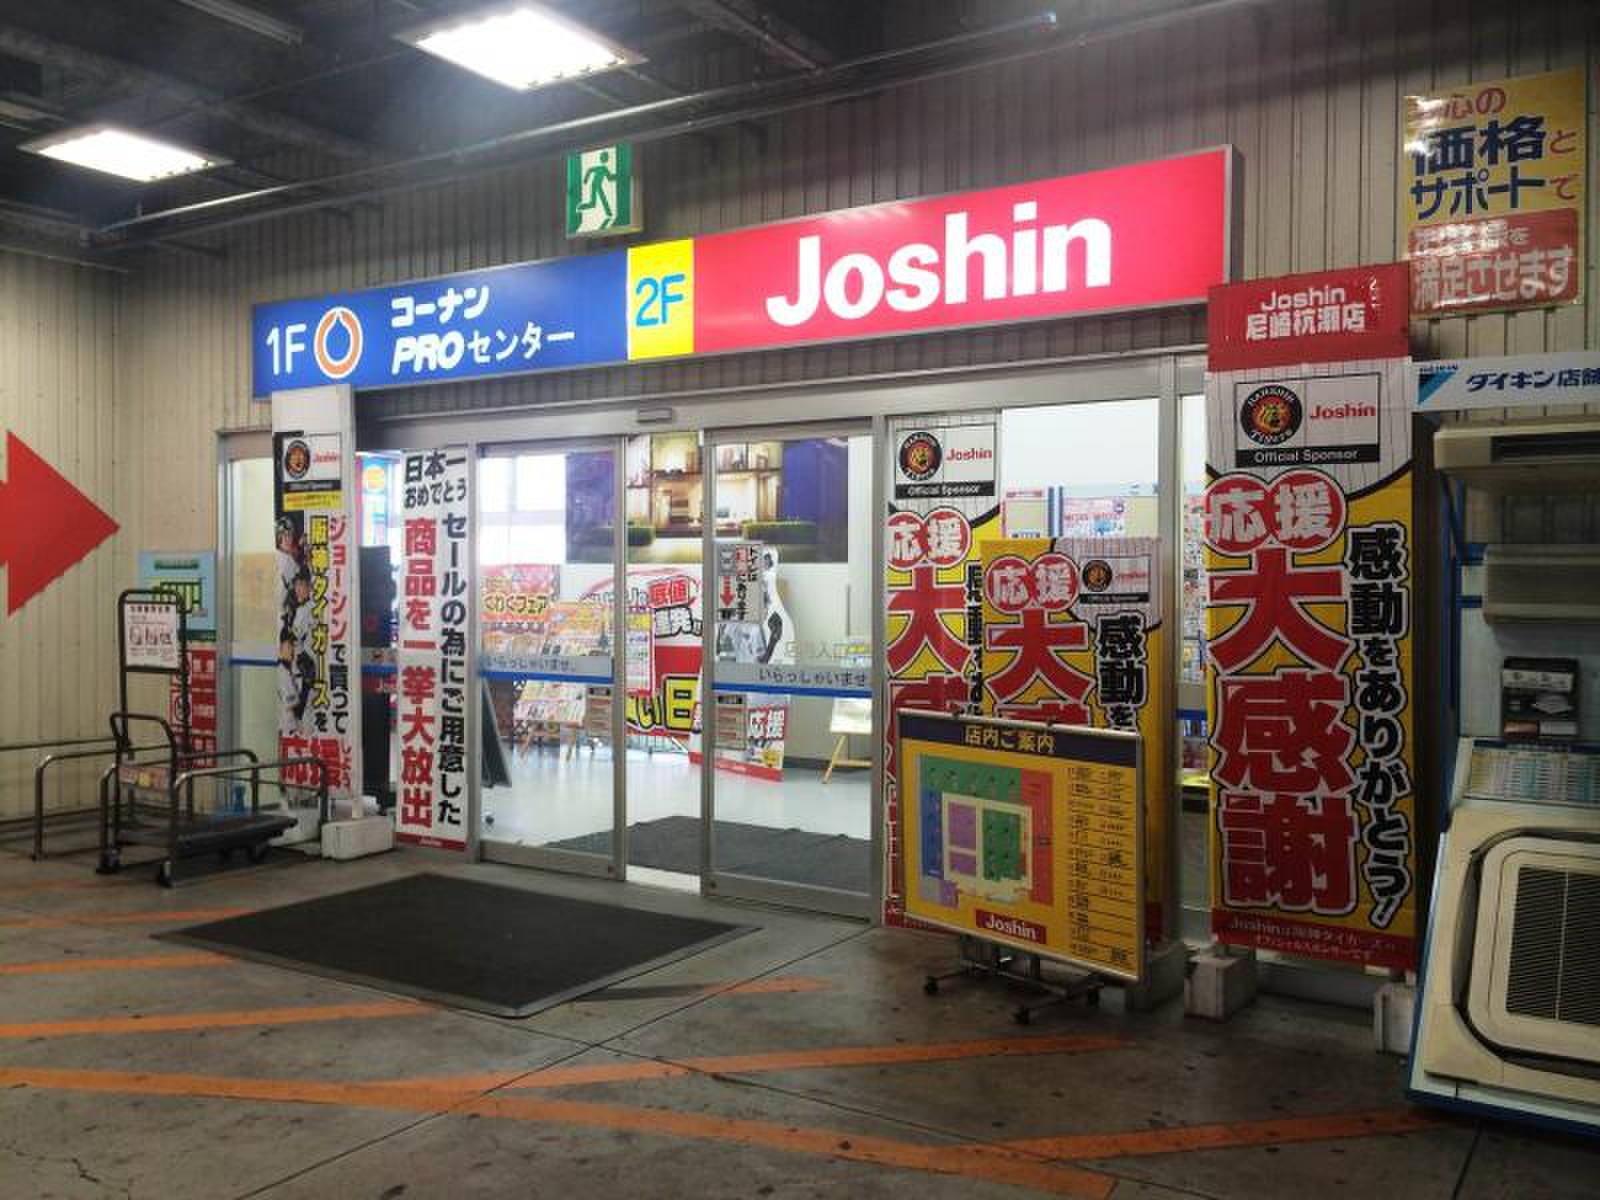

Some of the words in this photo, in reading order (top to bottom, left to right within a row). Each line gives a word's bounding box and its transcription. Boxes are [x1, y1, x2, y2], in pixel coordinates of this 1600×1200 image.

[766, 201, 1112, 326] Joshin
[391, 286, 490, 328] コーナン
[635, 274, 686, 326] 2F
[1261, 286, 1345, 311] Joshin
[266, 324, 307, 375] 1F
[1310, 402, 1376, 419] Joshin
[404, 451, 467, 484] 日本一
[947, 448, 993, 461] Joshin
[1254, 453, 1298, 464] Official
[1303, 449, 1358, 461] Sponsor
[404, 478, 467, 510] おめでとう
[1206, 480, 1334, 543] 応援
[400, 516, 437, 829] 商品を一挙大放出
[438, 512, 467, 827] セールの為にご用意した
[963, 723, 1056, 753] 店内ご案内
[1208, 547, 1356, 907] 大感謝
[984, 915, 1038, 942] Joshin
